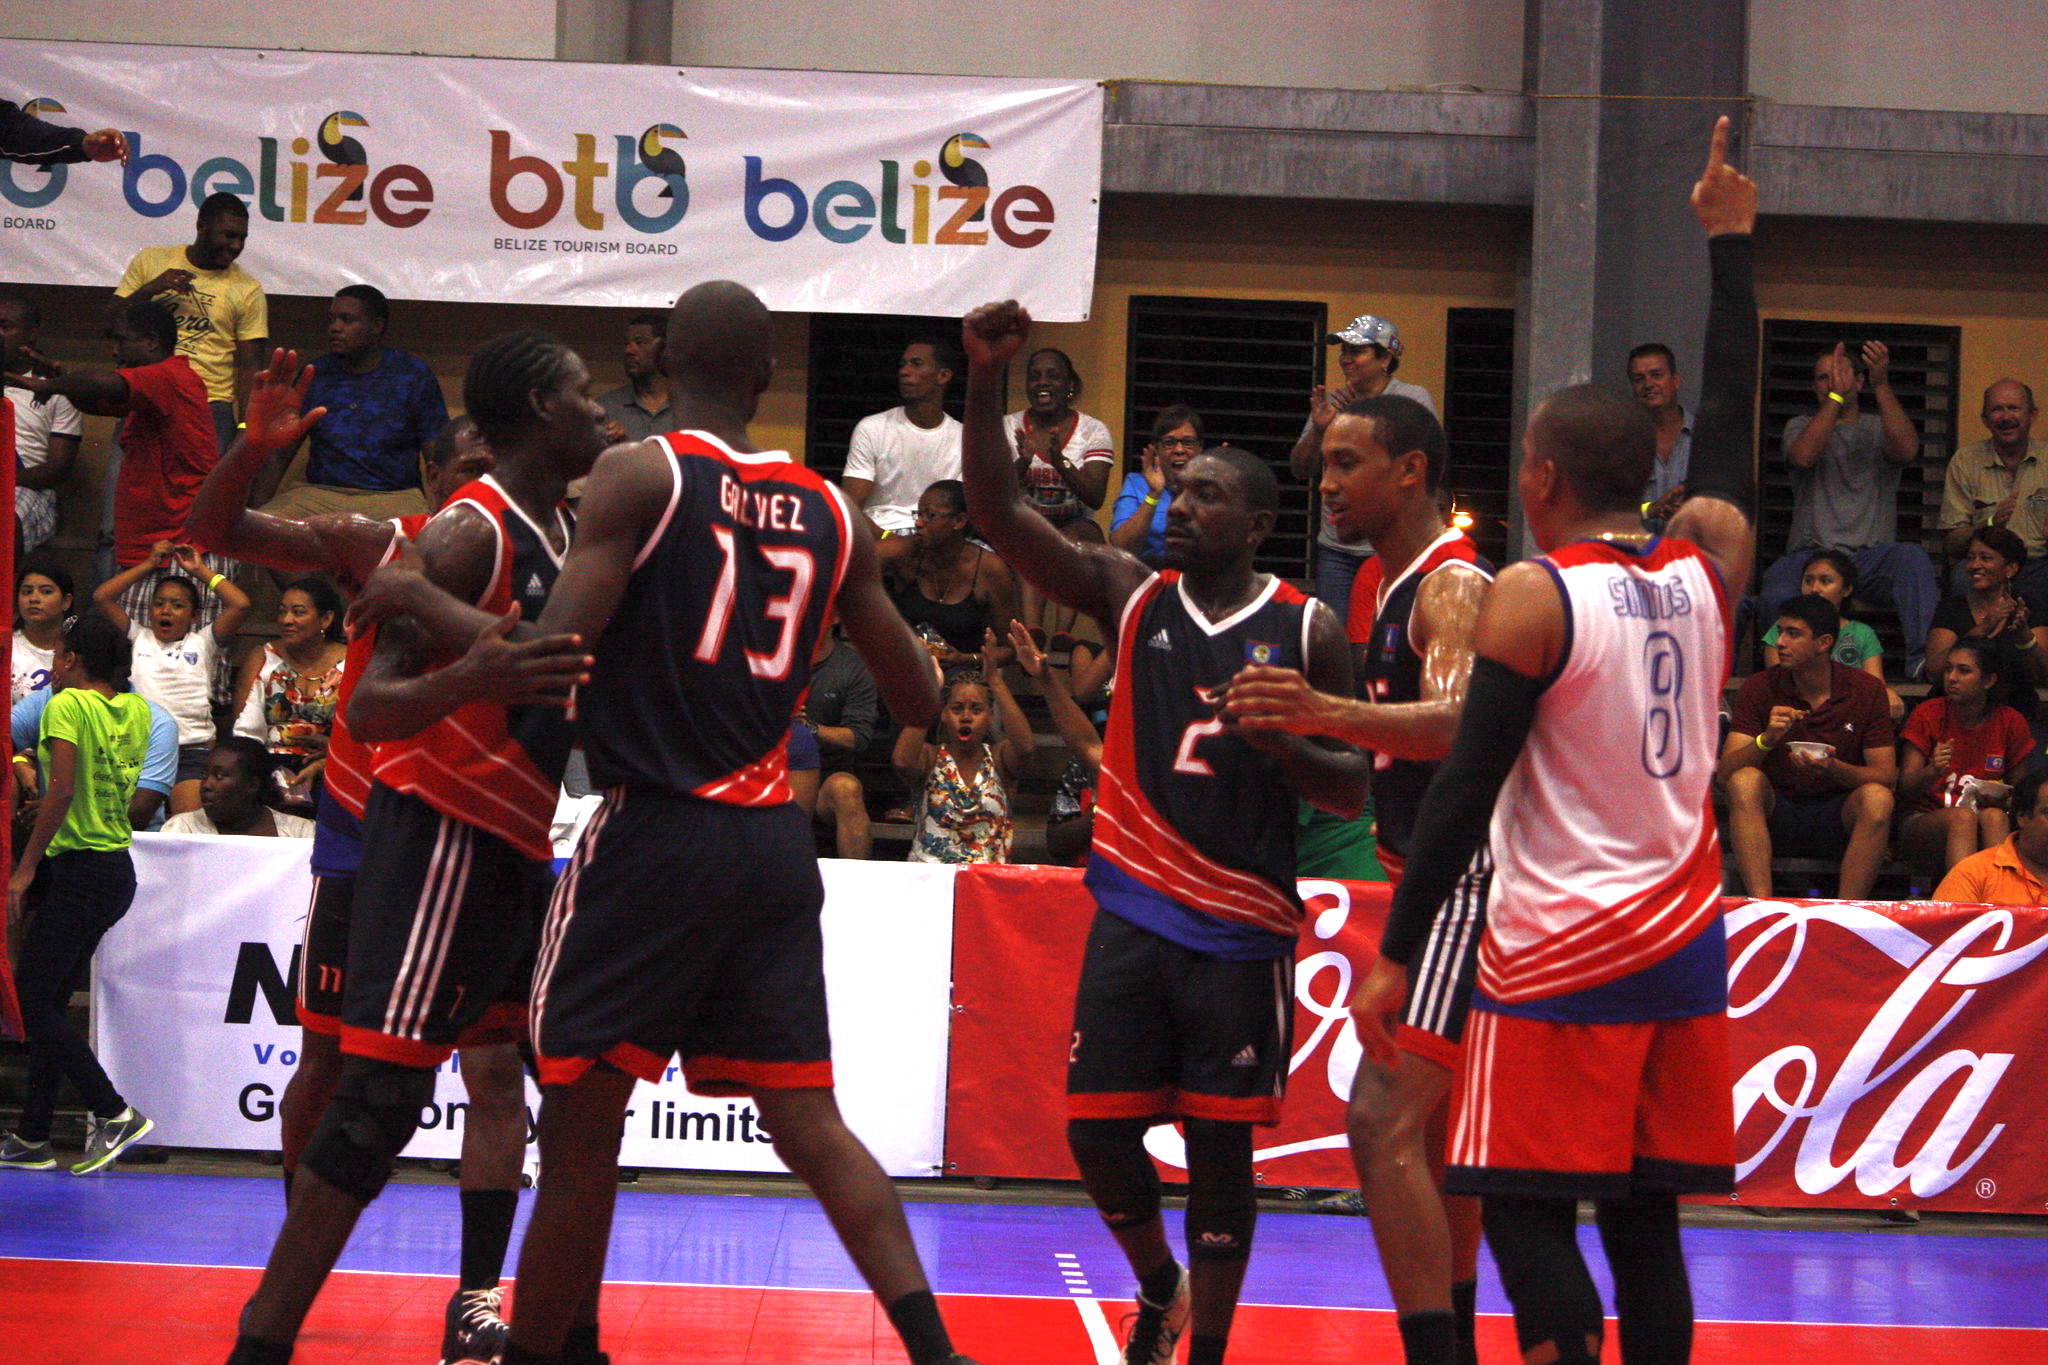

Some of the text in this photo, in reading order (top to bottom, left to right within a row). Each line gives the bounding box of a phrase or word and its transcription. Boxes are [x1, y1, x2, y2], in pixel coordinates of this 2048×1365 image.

[3, 217, 56, 231] BOARD
[121, 131, 434, 229] belize
[488, 128, 690, 234] btb
[742, 155, 1055, 249] belize
[494, 238, 678, 255] BELIZE TOURISM BOARD
[694, 523, 815, 681] 13
[1173, 685, 1224, 776] 2
[319, 964, 343, 993] 11
